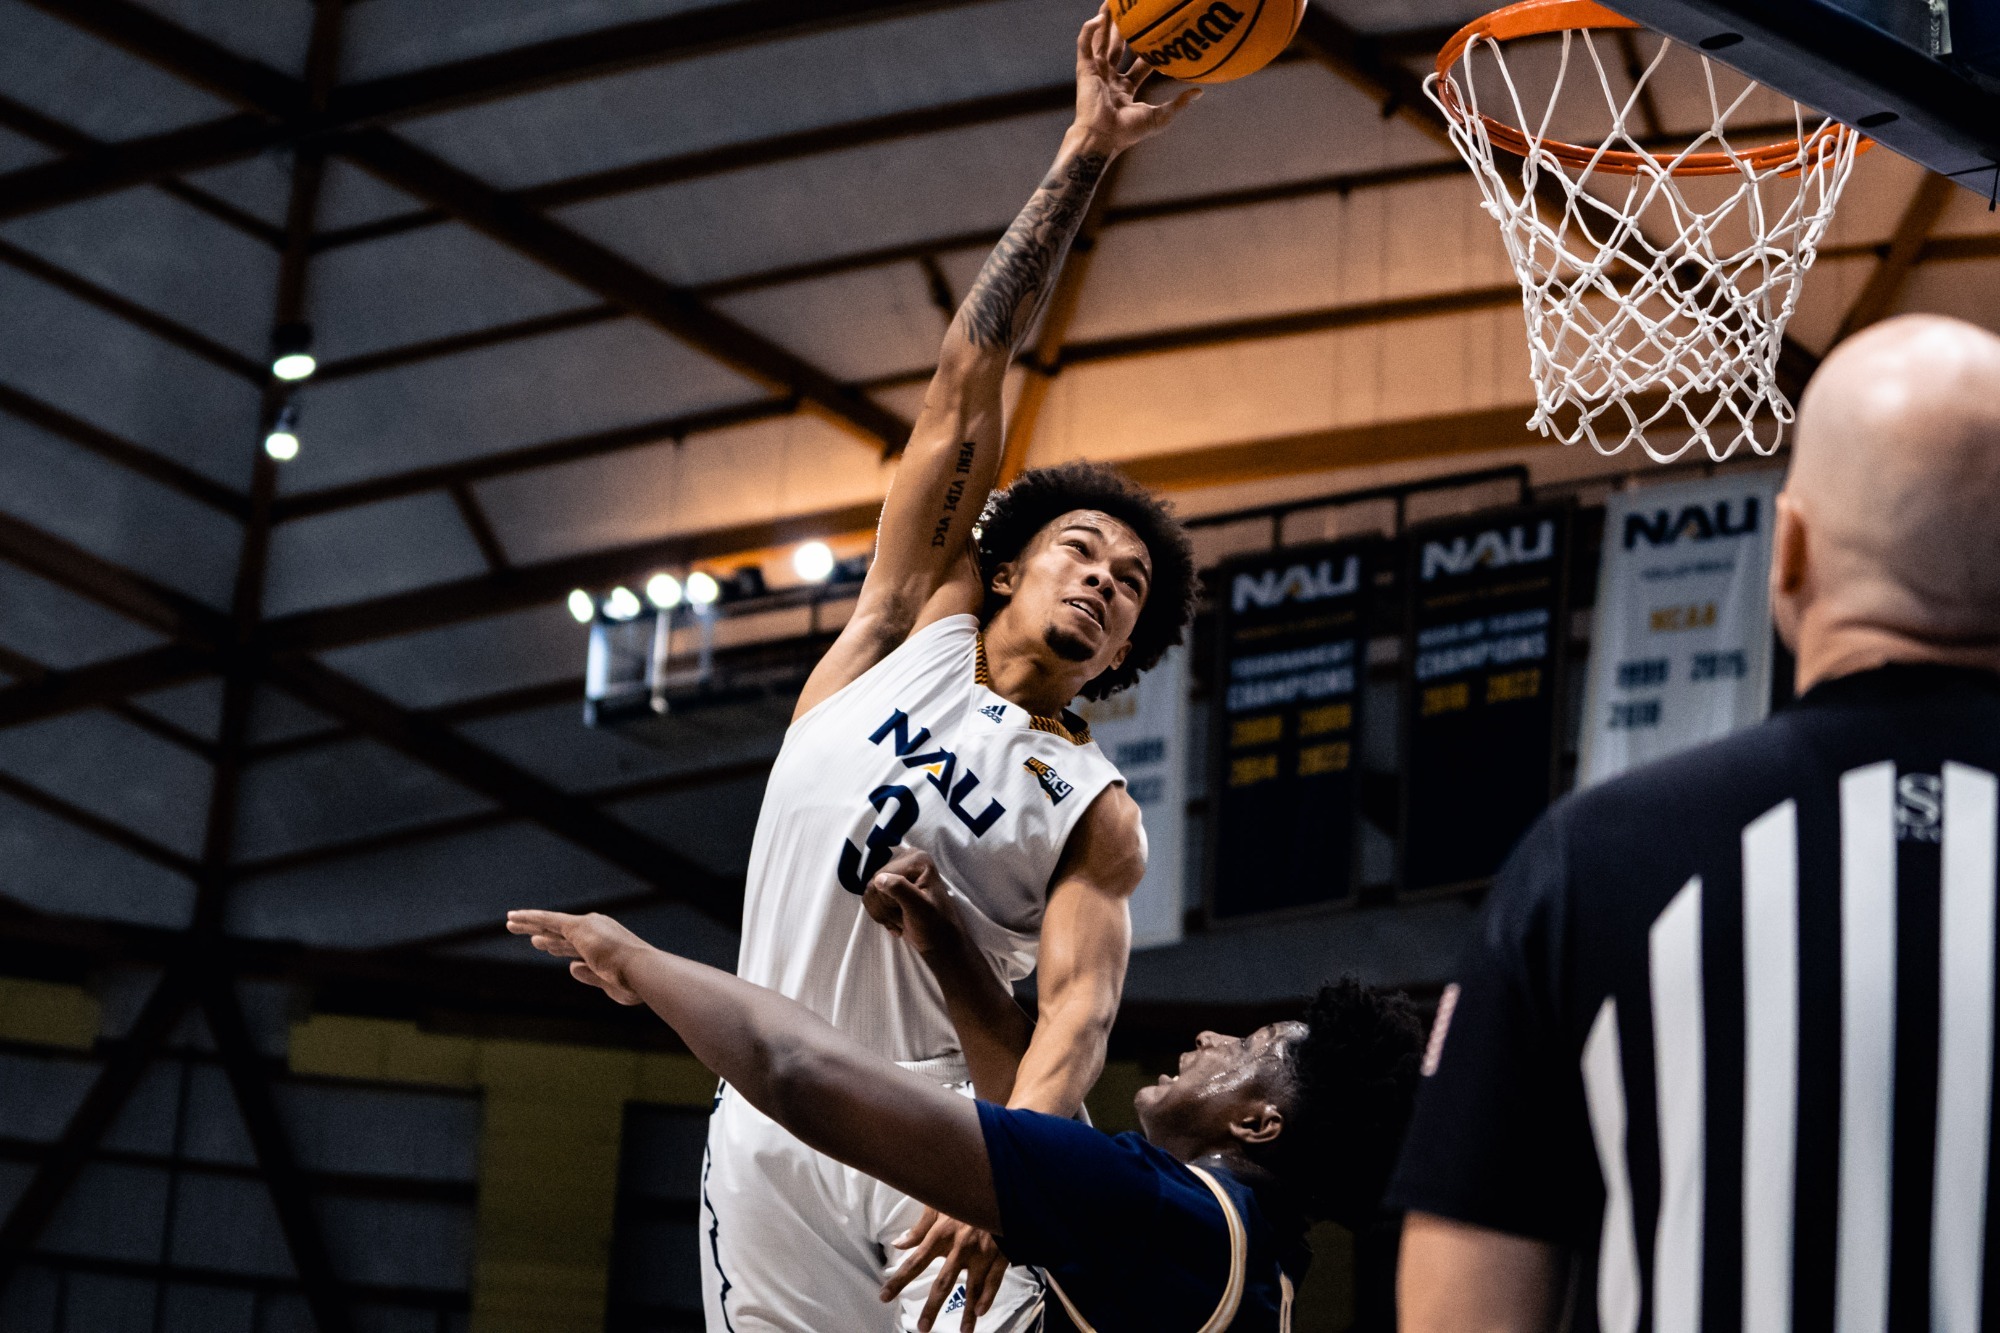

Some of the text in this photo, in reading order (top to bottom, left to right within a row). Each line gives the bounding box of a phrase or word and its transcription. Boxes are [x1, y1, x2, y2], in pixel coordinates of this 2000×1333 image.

[1138, 1, 1245, 67] Wilson
[943, 479, 965, 512] VIDI
[1624, 496, 1760, 552] NAU
[1420, 520, 1555, 581] NAU
[1231, 555, 1360, 615] NAU
[1415, 632, 1548, 681] CHAMPIONS
[1226, 666, 1355, 710] CHAMPIONS
[868, 707, 1007, 839] NAU
[1027, 757, 1073, 798] BIG SKY
[837, 783, 920, 896] 3
